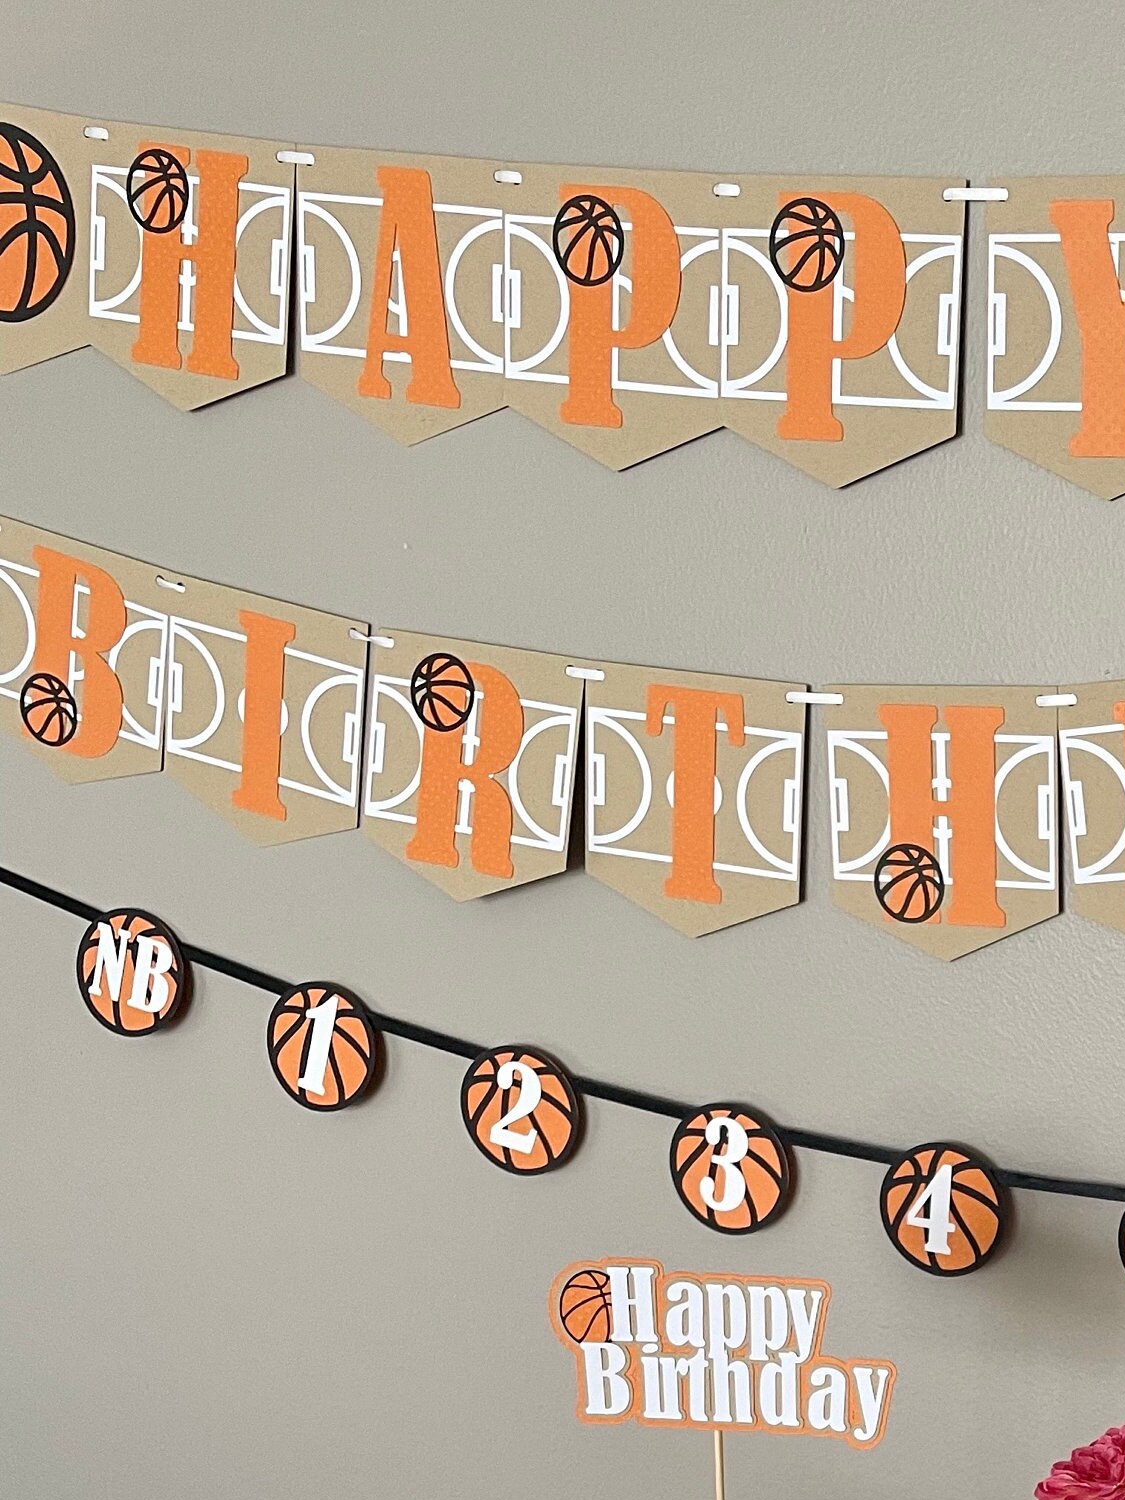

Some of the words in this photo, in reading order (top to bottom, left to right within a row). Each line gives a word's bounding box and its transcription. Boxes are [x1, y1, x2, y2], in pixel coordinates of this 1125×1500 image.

[88, 922, 174, 1014] NB
[297, 995, 341, 1097] 1
[489, 1061, 543, 1155] 2
[699, 1116, 749, 1212] 3
[907, 1164, 957, 1256] 4
[606, 1266, 823, 1364] Happy
[579, 1341, 890, 1442] Birthday
